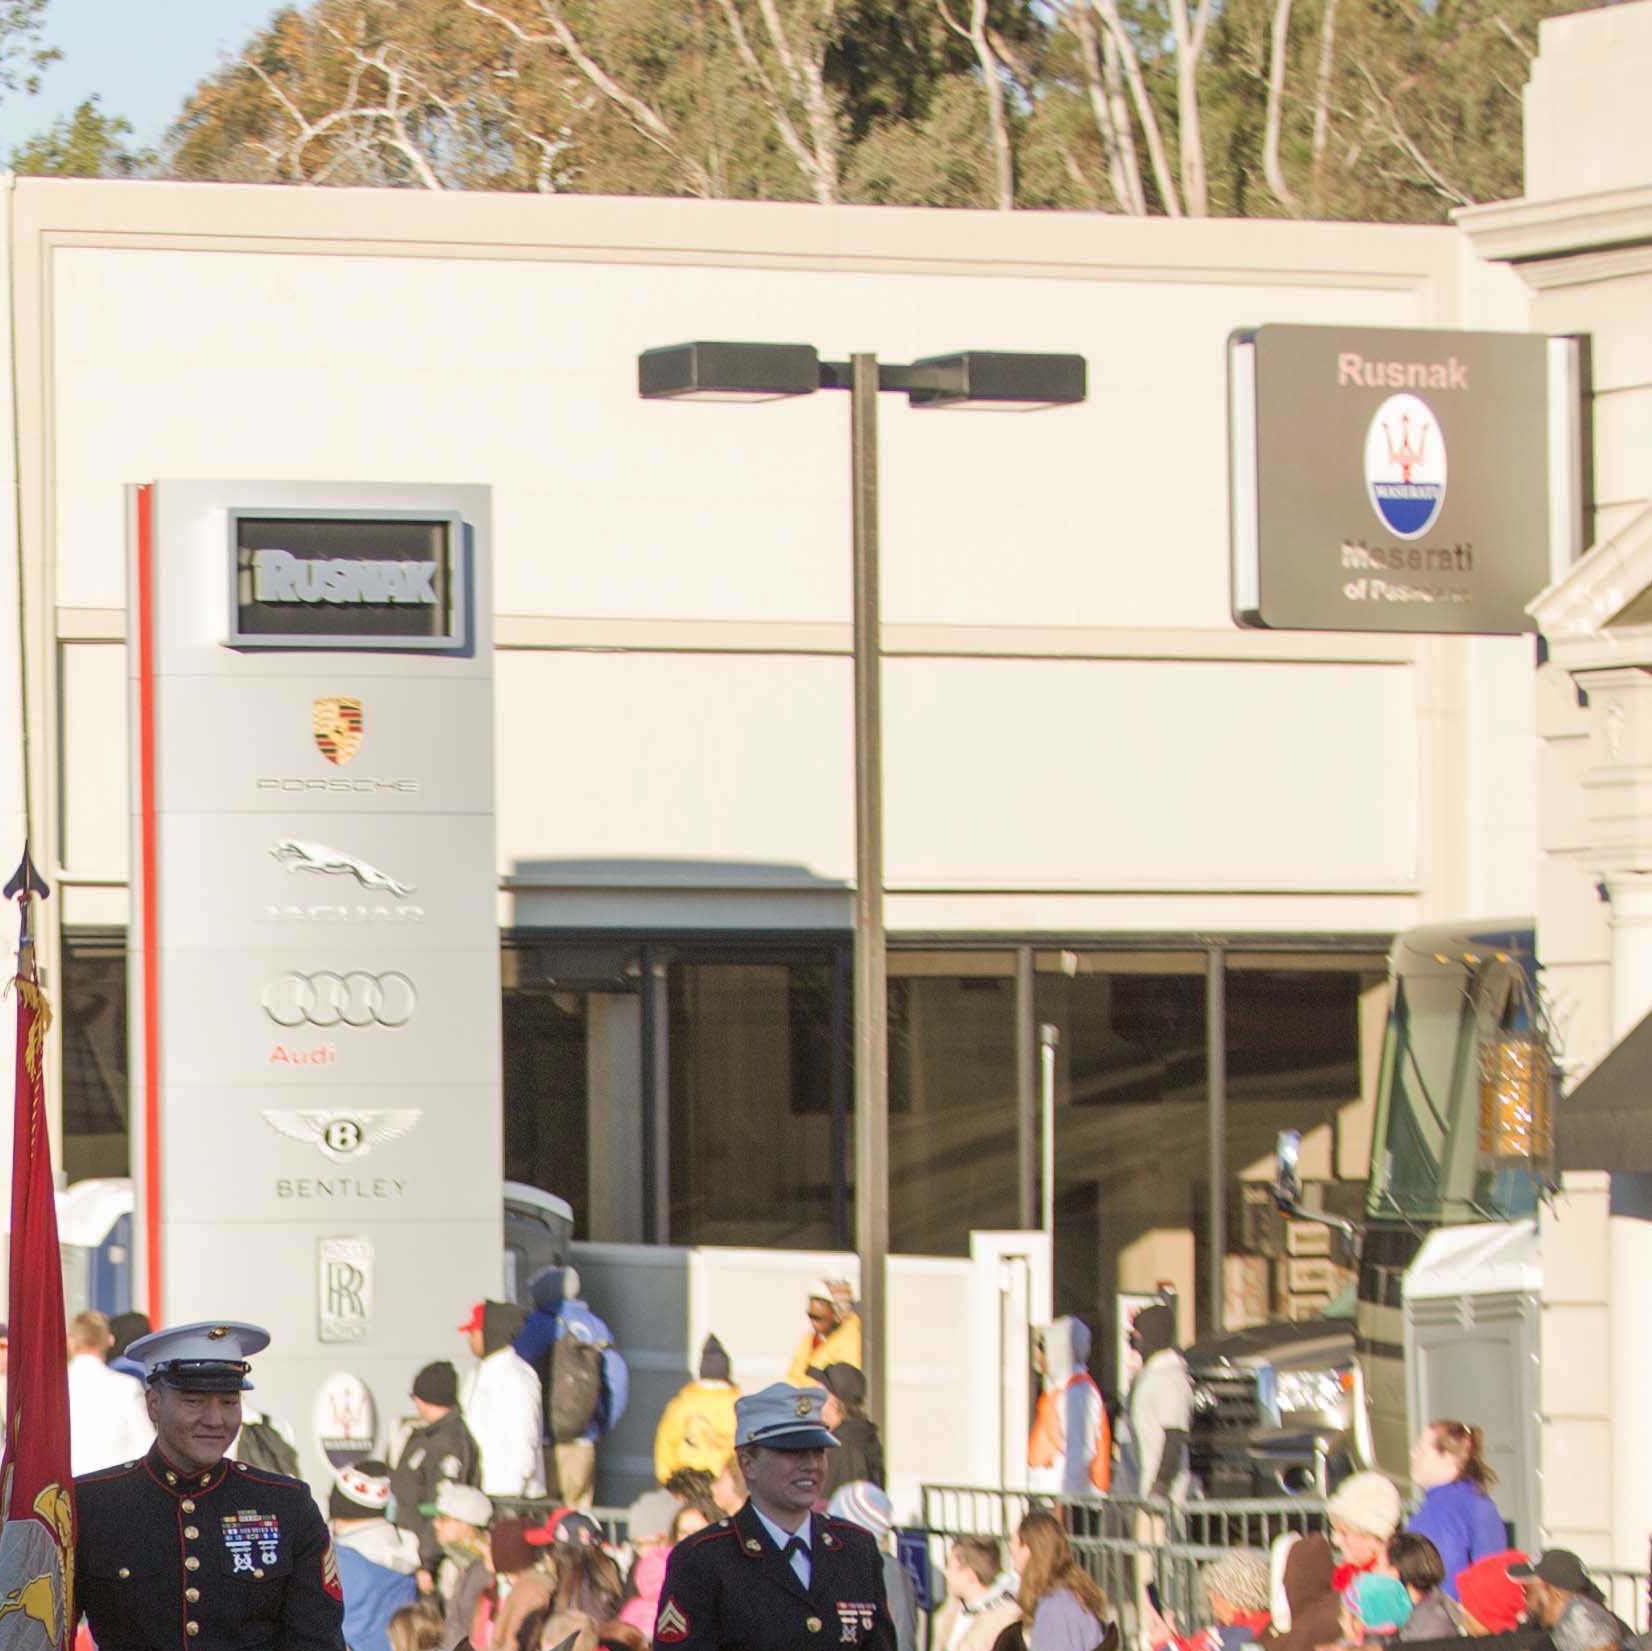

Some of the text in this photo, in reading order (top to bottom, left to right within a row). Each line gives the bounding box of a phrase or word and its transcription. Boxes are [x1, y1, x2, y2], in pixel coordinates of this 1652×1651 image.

[1338, 353, 1469, 390] Rusnak
[1341, 540, 1473, 571] Maserati
[251, 548, 440, 603] RUSNAK
[256, 777, 419, 793] PORSCHE
[269, 1044, 336, 1065] Audi
[275, 1178, 409, 1198] BENTLEY
